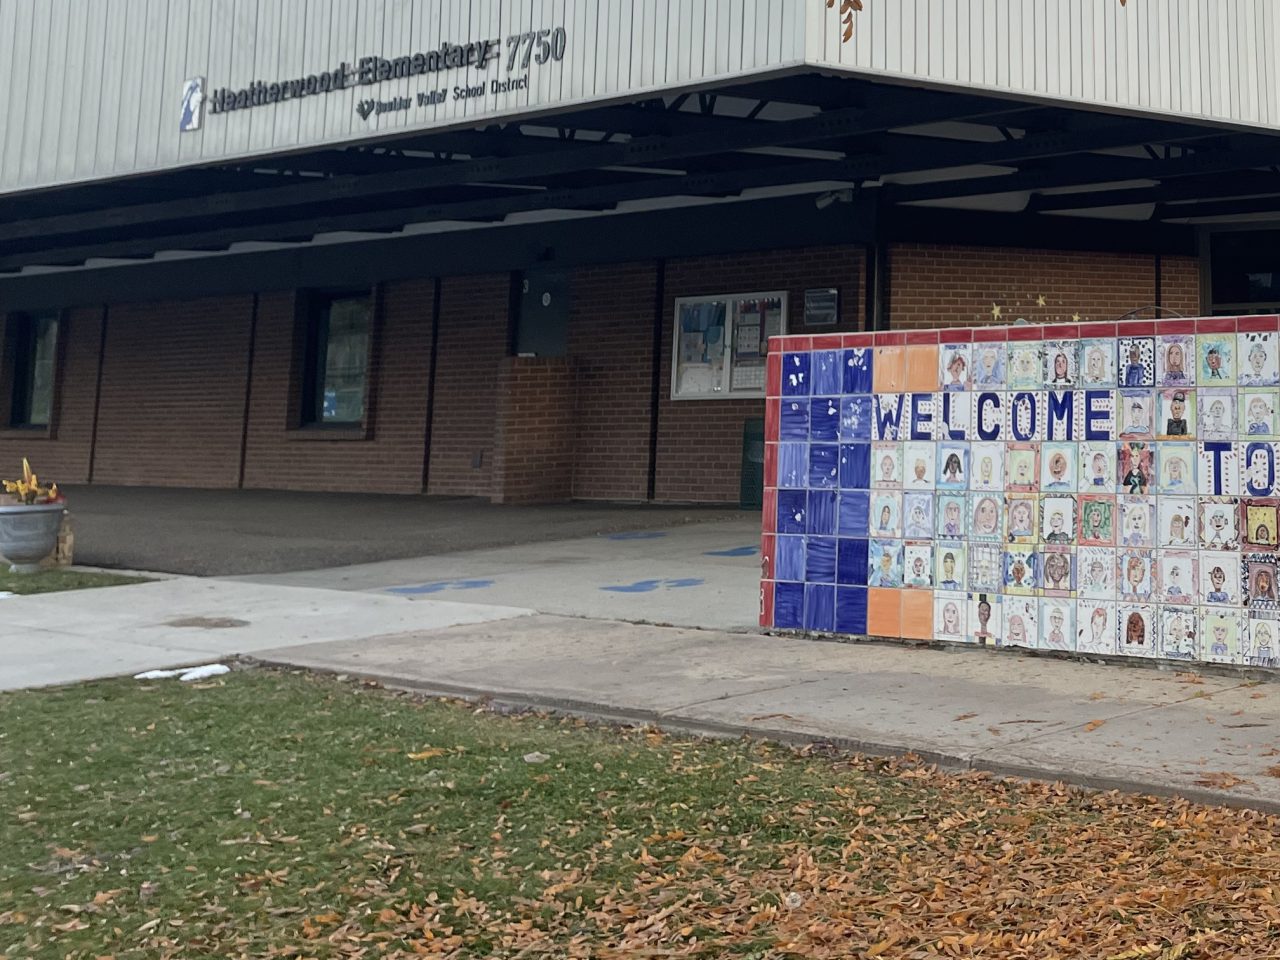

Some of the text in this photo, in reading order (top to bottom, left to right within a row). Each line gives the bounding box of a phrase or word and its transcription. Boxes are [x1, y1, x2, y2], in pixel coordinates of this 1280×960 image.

[506, 27, 567, 71] 7750
[212, 40, 488, 114] Heatherwood Elementary
[453, 82, 485, 101] School
[491, 74, 528, 94] District
[876, 390, 1111, 441] WELCOME
[1204, 441, 1273, 496] TO
